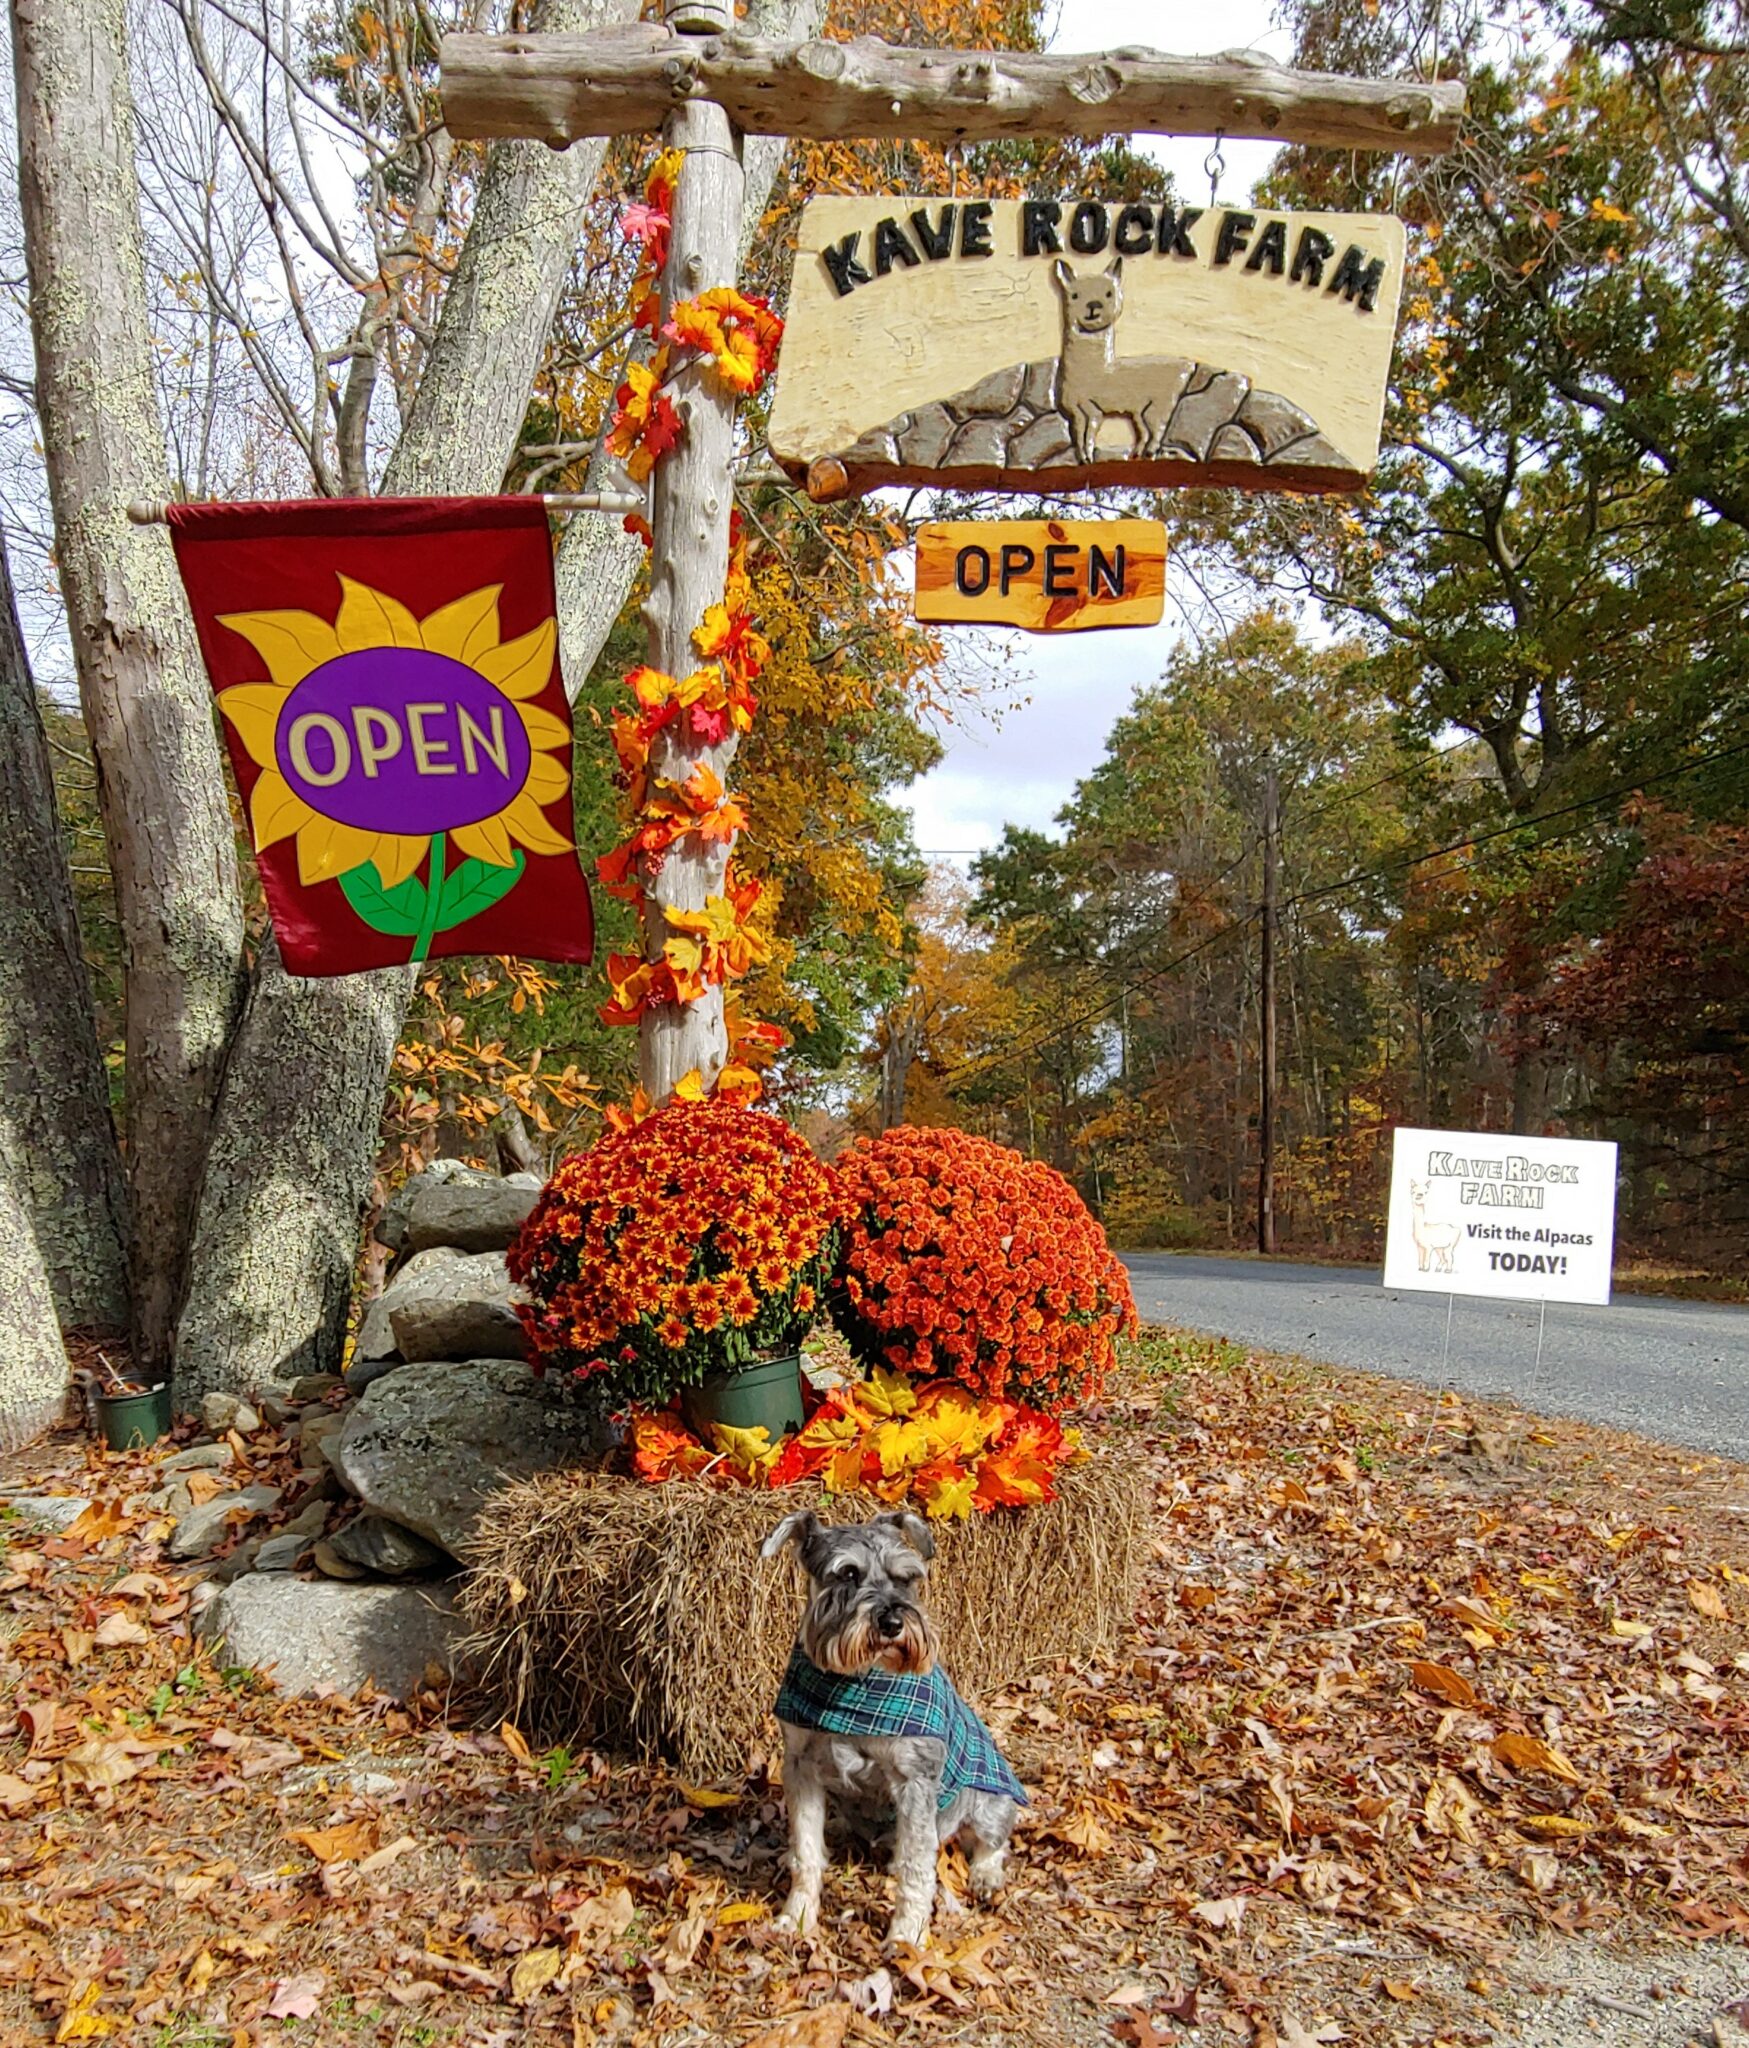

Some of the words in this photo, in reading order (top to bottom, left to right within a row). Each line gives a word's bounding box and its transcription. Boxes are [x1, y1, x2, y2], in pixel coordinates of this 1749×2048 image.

[821, 202, 994, 298] KAVE
[1021, 201, 1203, 259] ROCK
[1212, 211, 1386, 312] FARM
[955, 544, 1126, 597] OPEN
[288, 702, 510, 787] OPEN
[1428, 1151, 1502, 1179] KAVE
[1506, 1156, 1579, 1184] ROCK
[1460, 1182, 1544, 1209] FARM
[1467, 1224, 1502, 1240] Visit
[1505, 1226, 1531, 1242] the
[1534, 1228, 1593, 1247] Alpacas
[1488, 1252, 1567, 1275] TODAY!
